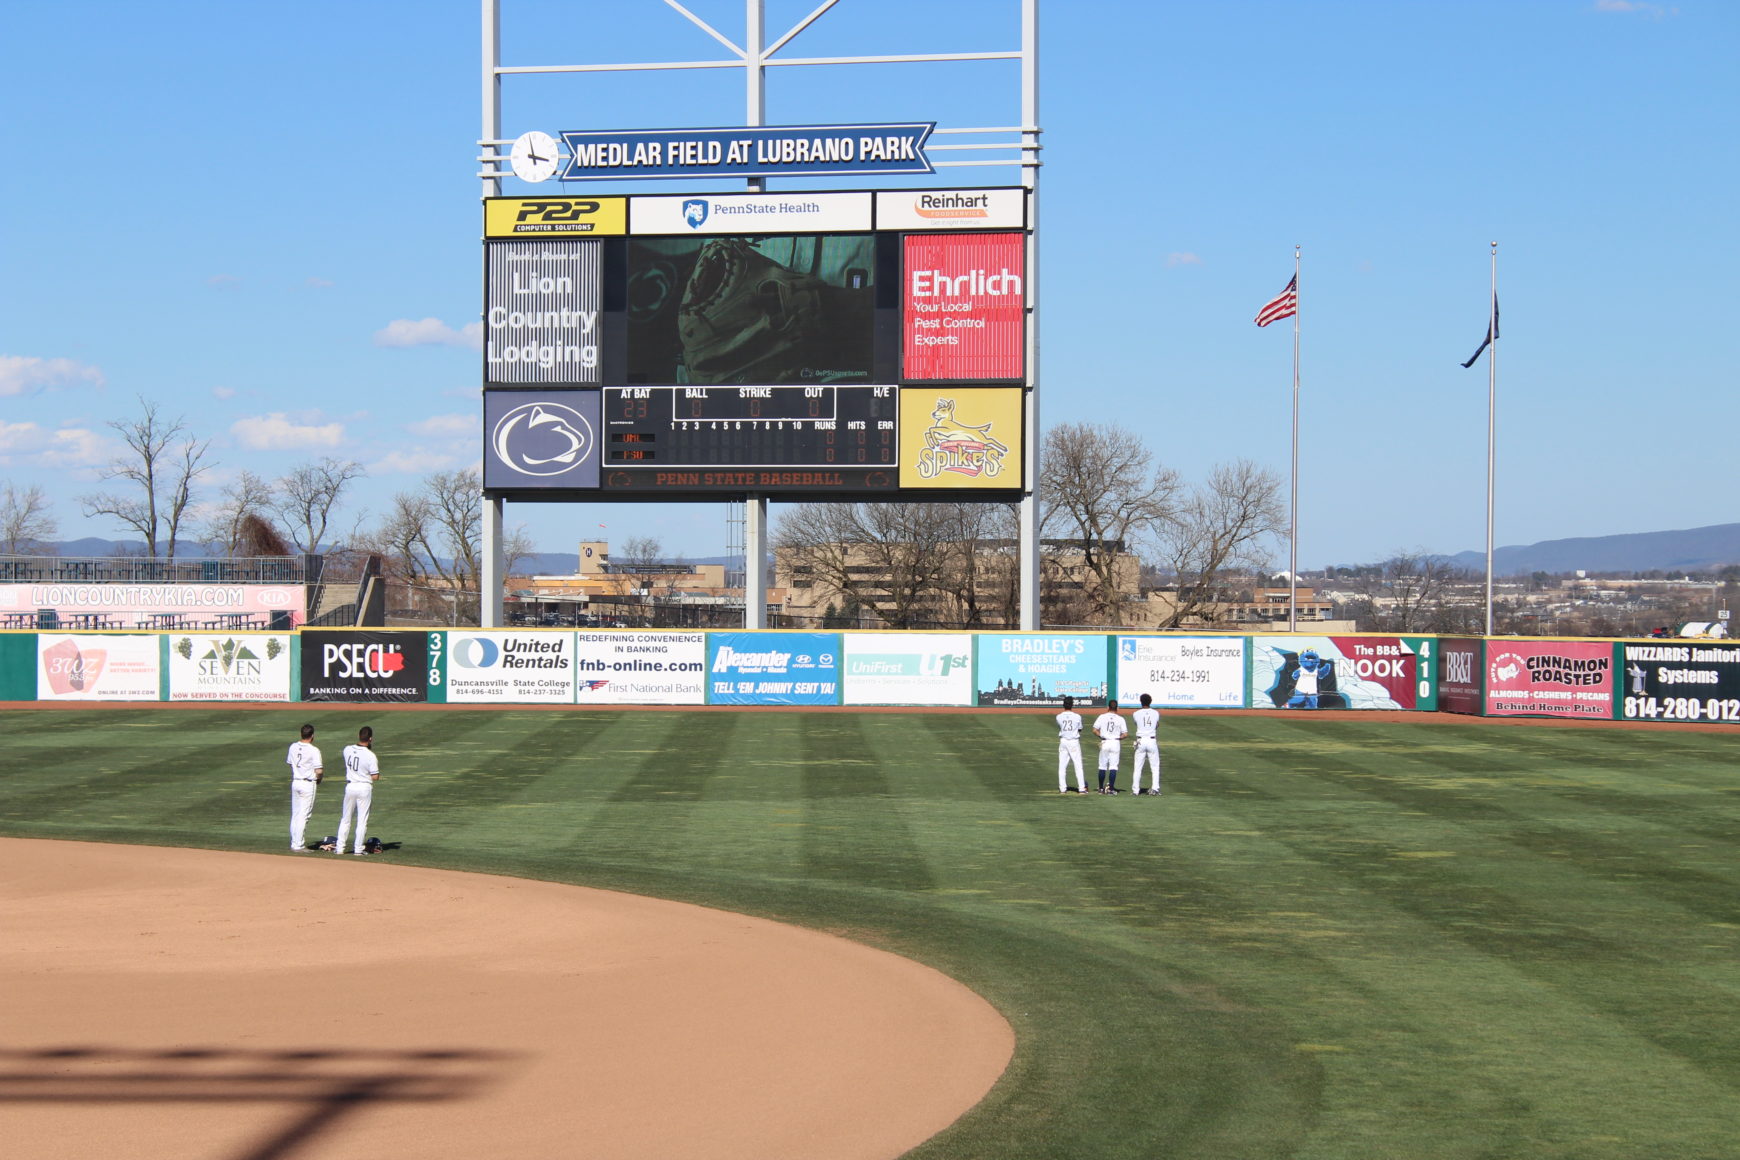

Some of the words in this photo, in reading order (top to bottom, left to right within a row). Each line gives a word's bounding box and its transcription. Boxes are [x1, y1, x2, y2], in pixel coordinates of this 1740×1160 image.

[577, 142, 662, 168] MEDLAR
[667, 140, 722, 165] FIELD
[726, 139, 752, 164] AT
[757, 137, 854, 163] LUBRANO
[859, 136, 915, 161] PARK
[921, 193, 988, 208] Reinhart
[516, 201, 600, 221] P2P
[714, 203, 776, 214] PennState
[779, 202, 820, 213] Health
[513, 272, 572, 294] Lion
[913, 268, 1021, 296] Ehrlich
[914, 302, 939, 312] Your
[941, 301, 972, 312] Local
[489, 306, 597, 333] Country
[914, 317, 940, 328] Pest
[943, 317, 985, 328] Control
[914, 334, 959, 346] Experts
[488, 340, 597, 368] Lodging
[621, 389, 631, 399] AT
[634, 388, 651, 398] BAT
[685, 388, 708, 398] BALL
[739, 388, 772, 398] STRIKE
[804, 387, 823, 398] OUT
[873, 387, 890, 397] H/E
[809, 400, 819, 417] 0
[671, 422, 675, 430] 1
[682, 422, 687, 430] 2
[694, 422, 699, 430] 3
[711, 422, 717, 430] 4
[723, 422, 729, 430] 5
[735, 422, 741, 430] 6
[753, 422, 757, 430] 7
[765, 422, 770, 430] 8
[778, 422, 783, 430] 9
[792, 422, 802, 430] 10
[815, 421, 836, 430] RUNS
[848, 421, 865, 430] HITS
[877, 421, 893, 429] ERR
[656, 473, 700, 485] PENN
[704, 473, 755, 485] STATE
[760, 473, 843, 485] BASEBALL
[32, 587, 244, 606] LIONCOUNTRYKIA.COM
[263, 591, 285, 602] KIA
[503, 638, 564, 653] United
[1002, 639, 1084, 653] BRADLEY'S
[1354, 645, 1373, 655] The
[198, 640, 260, 675] SEVEN
[1181, 645, 1203, 659] Boyles
[1206, 646, 1240, 657] Insurance
[1625, 646, 1690, 661] WIZZARDS
[323, 644, 394, 678] PSECU
[502, 655, 568, 669] Rentals
[712, 649, 791, 672] Alexander
[1009, 654, 1076, 664] CHEESESTEAKS
[1526, 655, 1608, 672] CINNAMON
[579, 659, 703, 672] fnb-online.com
[852, 661, 904, 673] UniFirst
[1018, 664, 1026, 673] &
[1028, 664, 1067, 673] HOAGIES
[1339, 659, 1405, 678] NOOK
[1446, 651, 1473, 683] BB&T
[198, 677, 261, 685] MOUNTAINS
[1150, 670, 1210, 682] 814-234-1991
[1531, 669, 1603, 686] ROASTED
[1658, 667, 1718, 684] Systems
[451, 679, 509, 687] Duncansville
[537, 680, 571, 688] College
[608, 683, 627, 693] First
[630, 683, 673, 693] National
[675, 683, 702, 693] Bank
[714, 682, 735, 694] TELL
[755, 682, 793, 694] JOHNNY
[794, 682, 819, 694] SENT
[820, 683, 836, 694] YA!
[1123, 692, 1141, 700] Aut
[1168, 692, 1195, 700] Home
[1219, 691, 1239, 701] Life
[1490, 690, 1529, 698] ALMONDS
[1533, 691, 1572, 699] CASHEWS
[1577, 692, 1610, 700] PECANS
[1496, 703, 1535, 711] Behind
[1539, 704, 1571, 712] Home
[1574, 705, 1602, 713] Plate
[1062, 720, 1073, 732] 23
[1106, 721, 1115, 732] 13
[1143, 716, 1152, 727] 14
[297, 753, 302, 768] 2
[347, 755, 359, 772] 40
